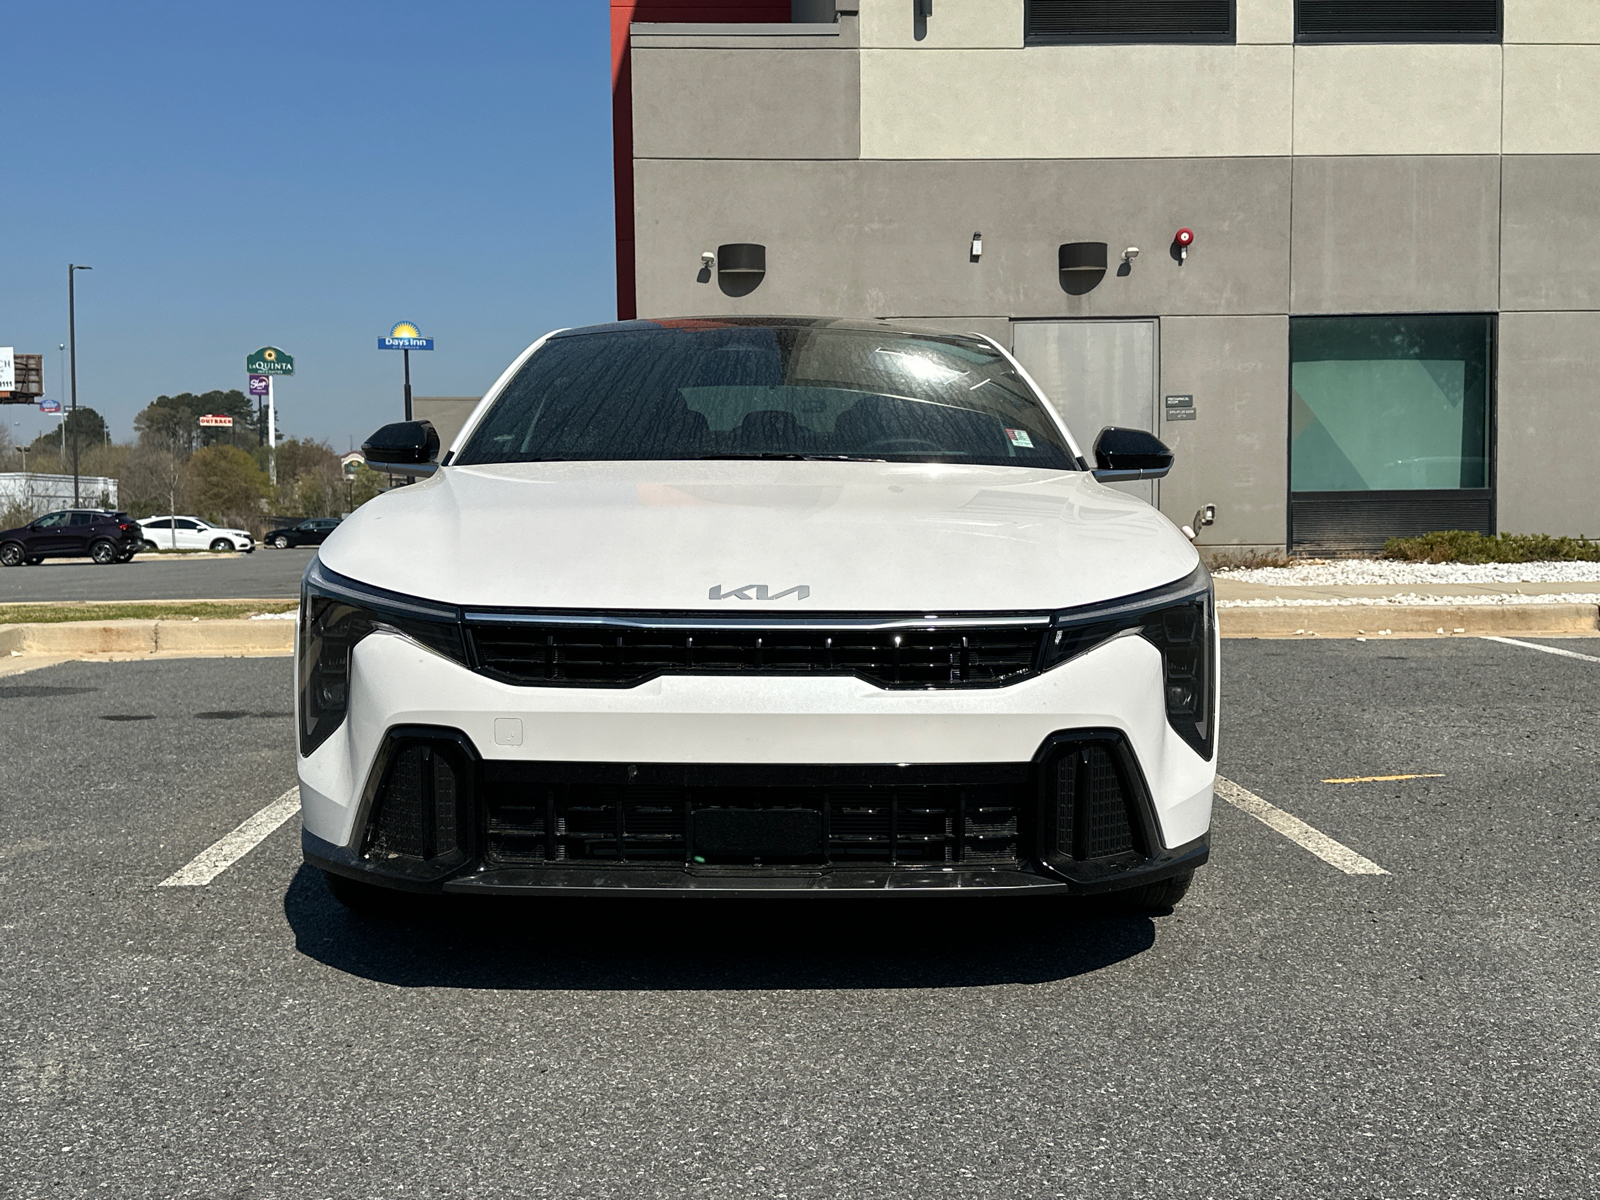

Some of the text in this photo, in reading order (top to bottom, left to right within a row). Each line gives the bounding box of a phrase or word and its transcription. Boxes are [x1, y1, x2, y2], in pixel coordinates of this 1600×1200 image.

[385, 338, 426, 346] Days Inn
[256, 361, 292, 371] QUINTA
